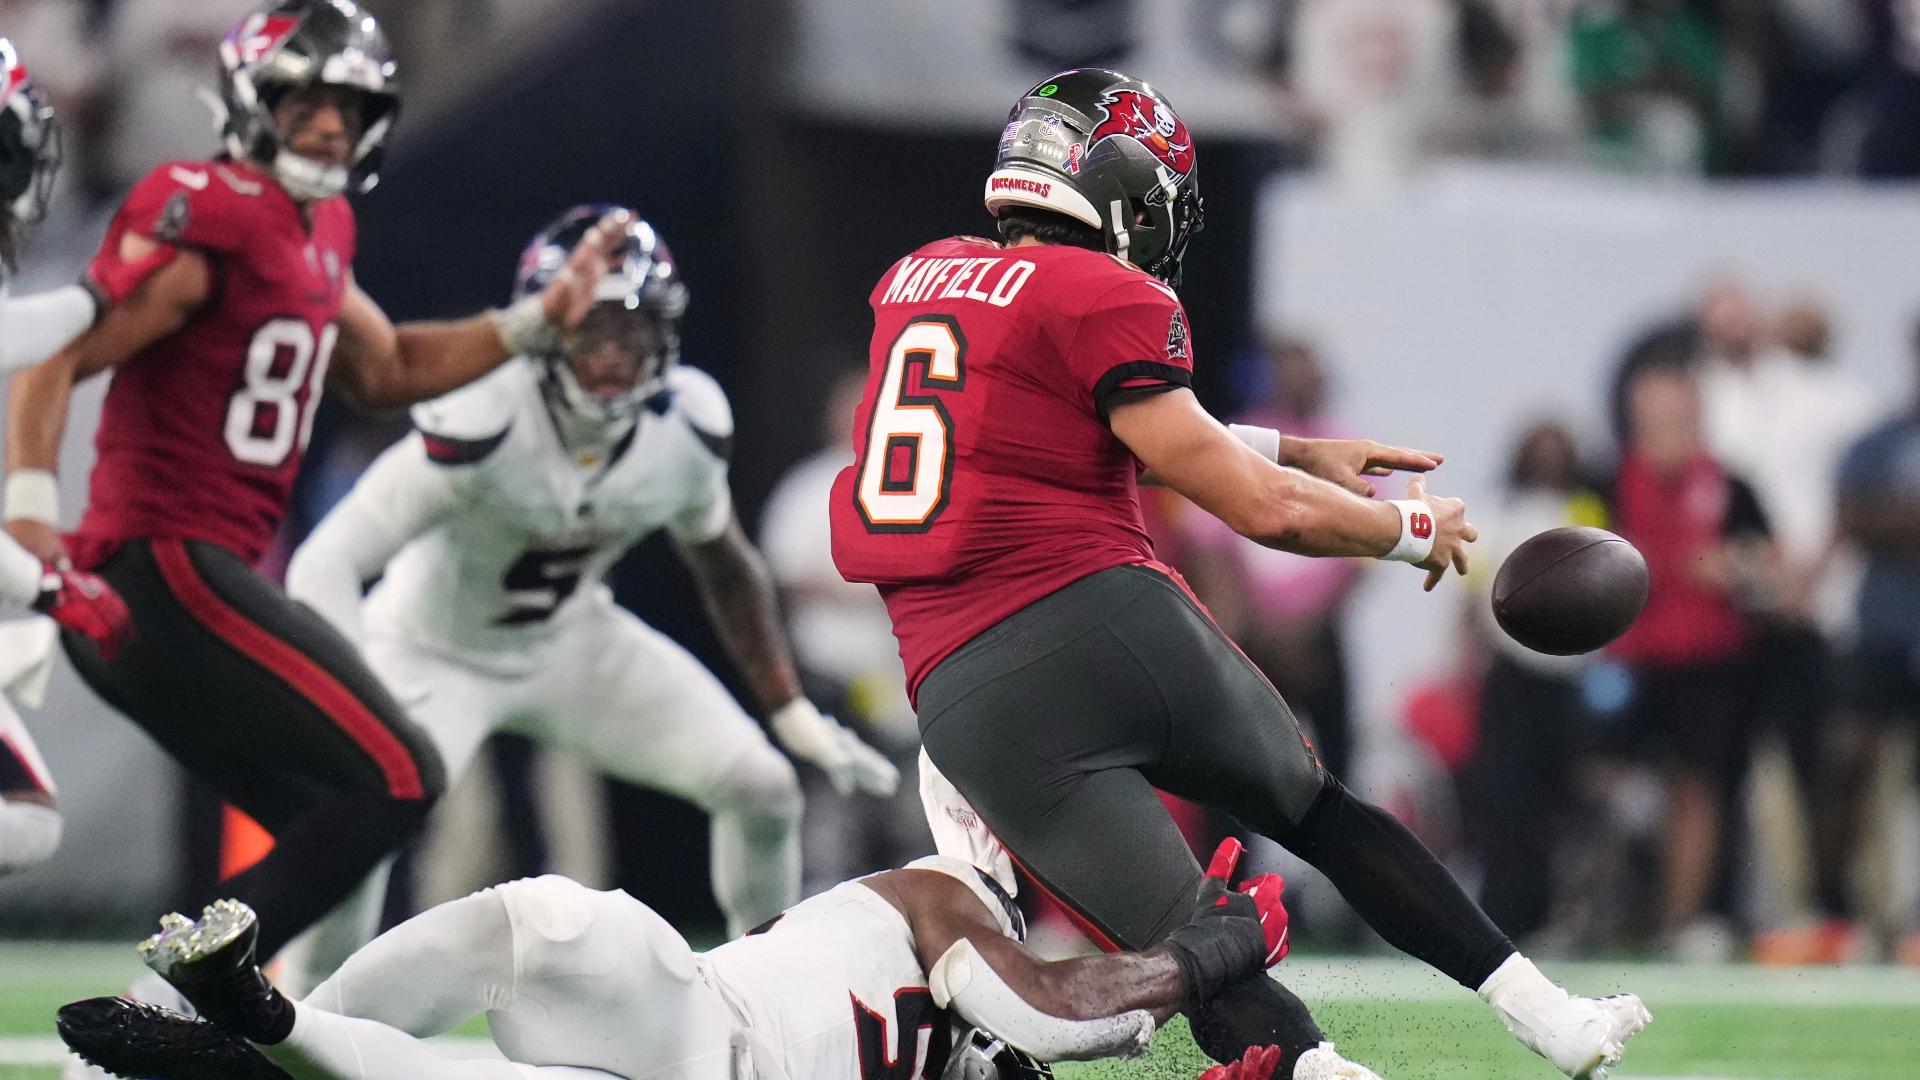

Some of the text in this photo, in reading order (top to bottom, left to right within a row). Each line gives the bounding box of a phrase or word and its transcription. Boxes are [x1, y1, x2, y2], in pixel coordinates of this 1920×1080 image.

[991, 177, 1051, 198] BUCCANEERS
[881, 256, 1036, 307] MAYFIELD
[853, 313, 968, 534] 6
[491, 546, 599, 627] 5
